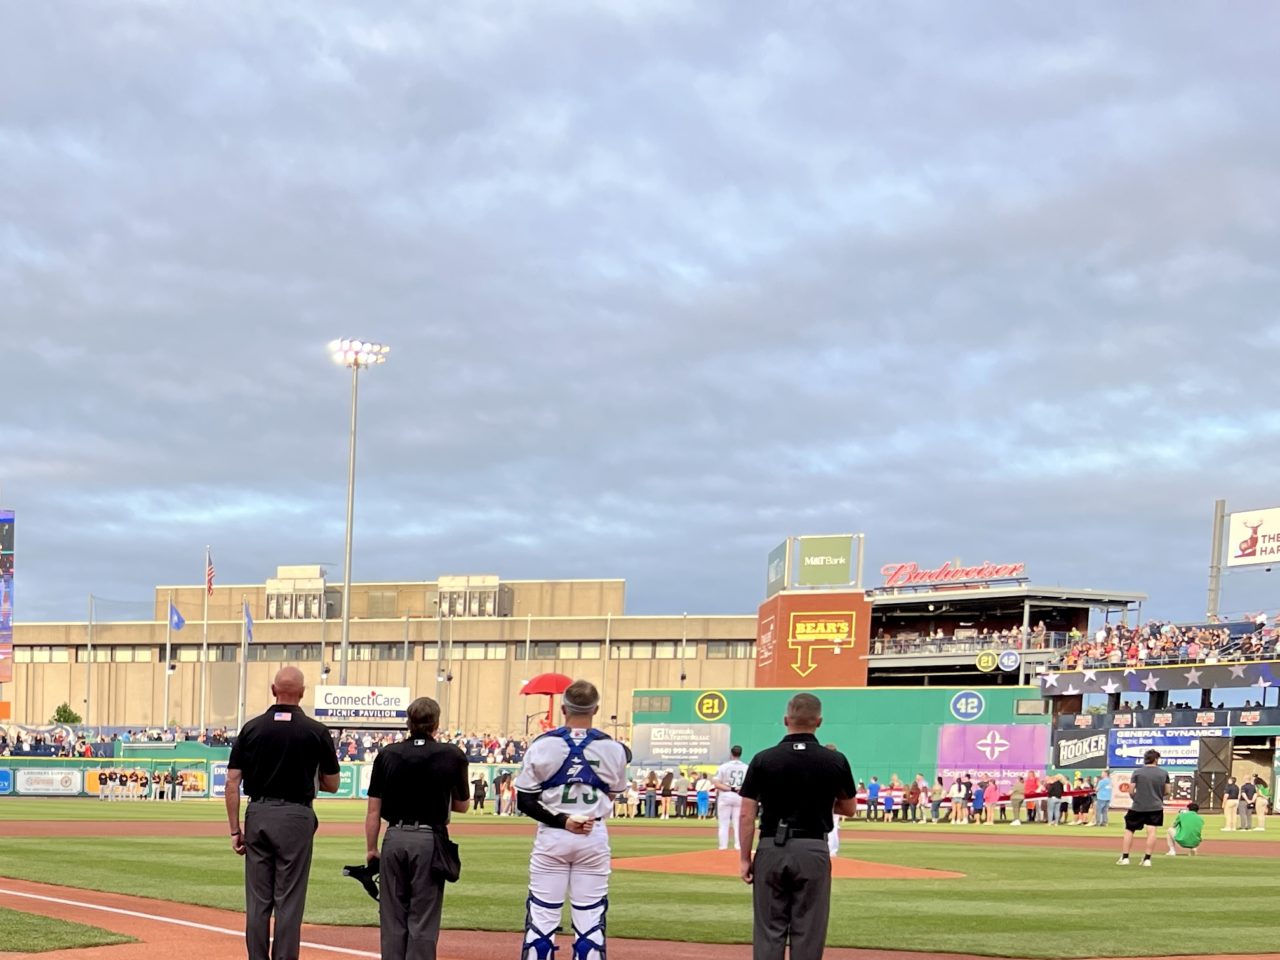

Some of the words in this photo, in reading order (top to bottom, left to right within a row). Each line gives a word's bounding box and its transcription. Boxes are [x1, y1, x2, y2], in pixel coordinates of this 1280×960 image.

[826, 556, 846, 565] Bank
[880, 560, 1024, 587] Budweiser
[795, 622, 849, 634] BEAR'S
[980, 655, 992, 667] 21
[1002, 655, 1016, 666] 42
[324, 691, 401, 706] ConnectiCare
[702, 698, 719, 714] 21
[956, 698, 979, 713] 42
[328, 709, 356, 717] PICNIC
[359, 710, 397, 718] PAVILION
[1166, 729, 1223, 737] DYNAMICS
[1060, 735, 1107, 760] HOOKER
[729, 770, 743, 786] 53
